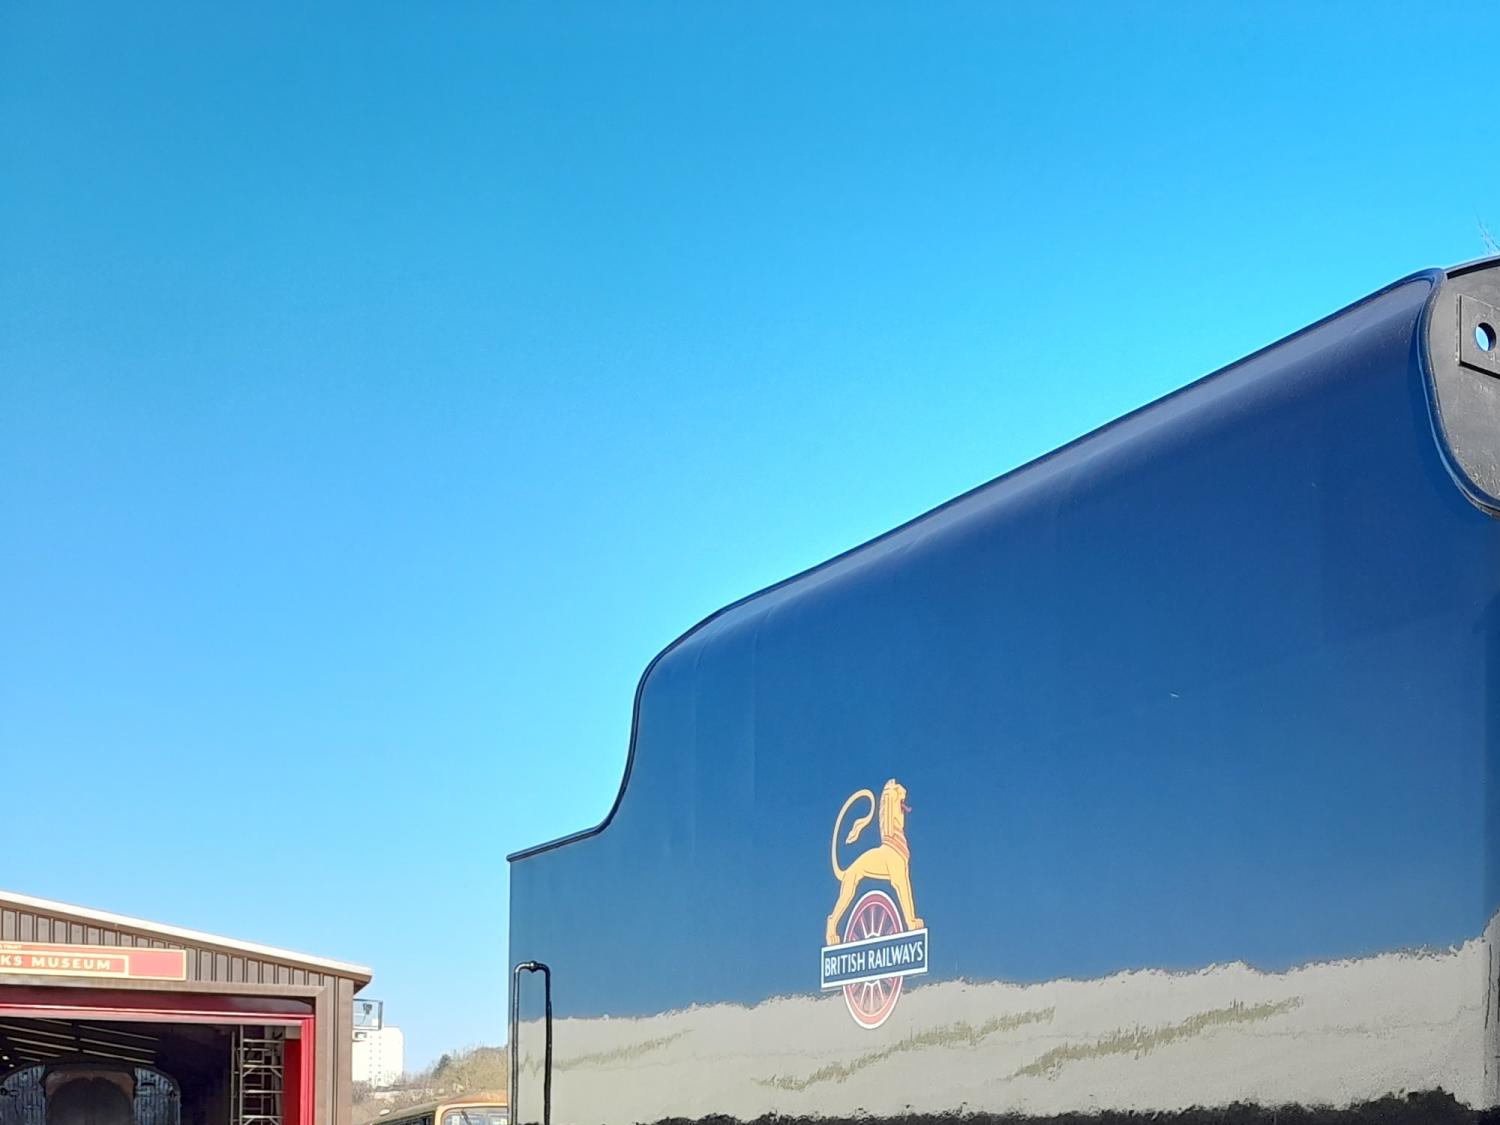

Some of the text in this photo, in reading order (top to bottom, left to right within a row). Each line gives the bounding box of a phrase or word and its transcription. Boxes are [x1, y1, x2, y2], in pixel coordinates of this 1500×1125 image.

[31, 956, 111, 970] MUSEUM
[824, 941, 924, 977] BRITISH RAILWAYS
